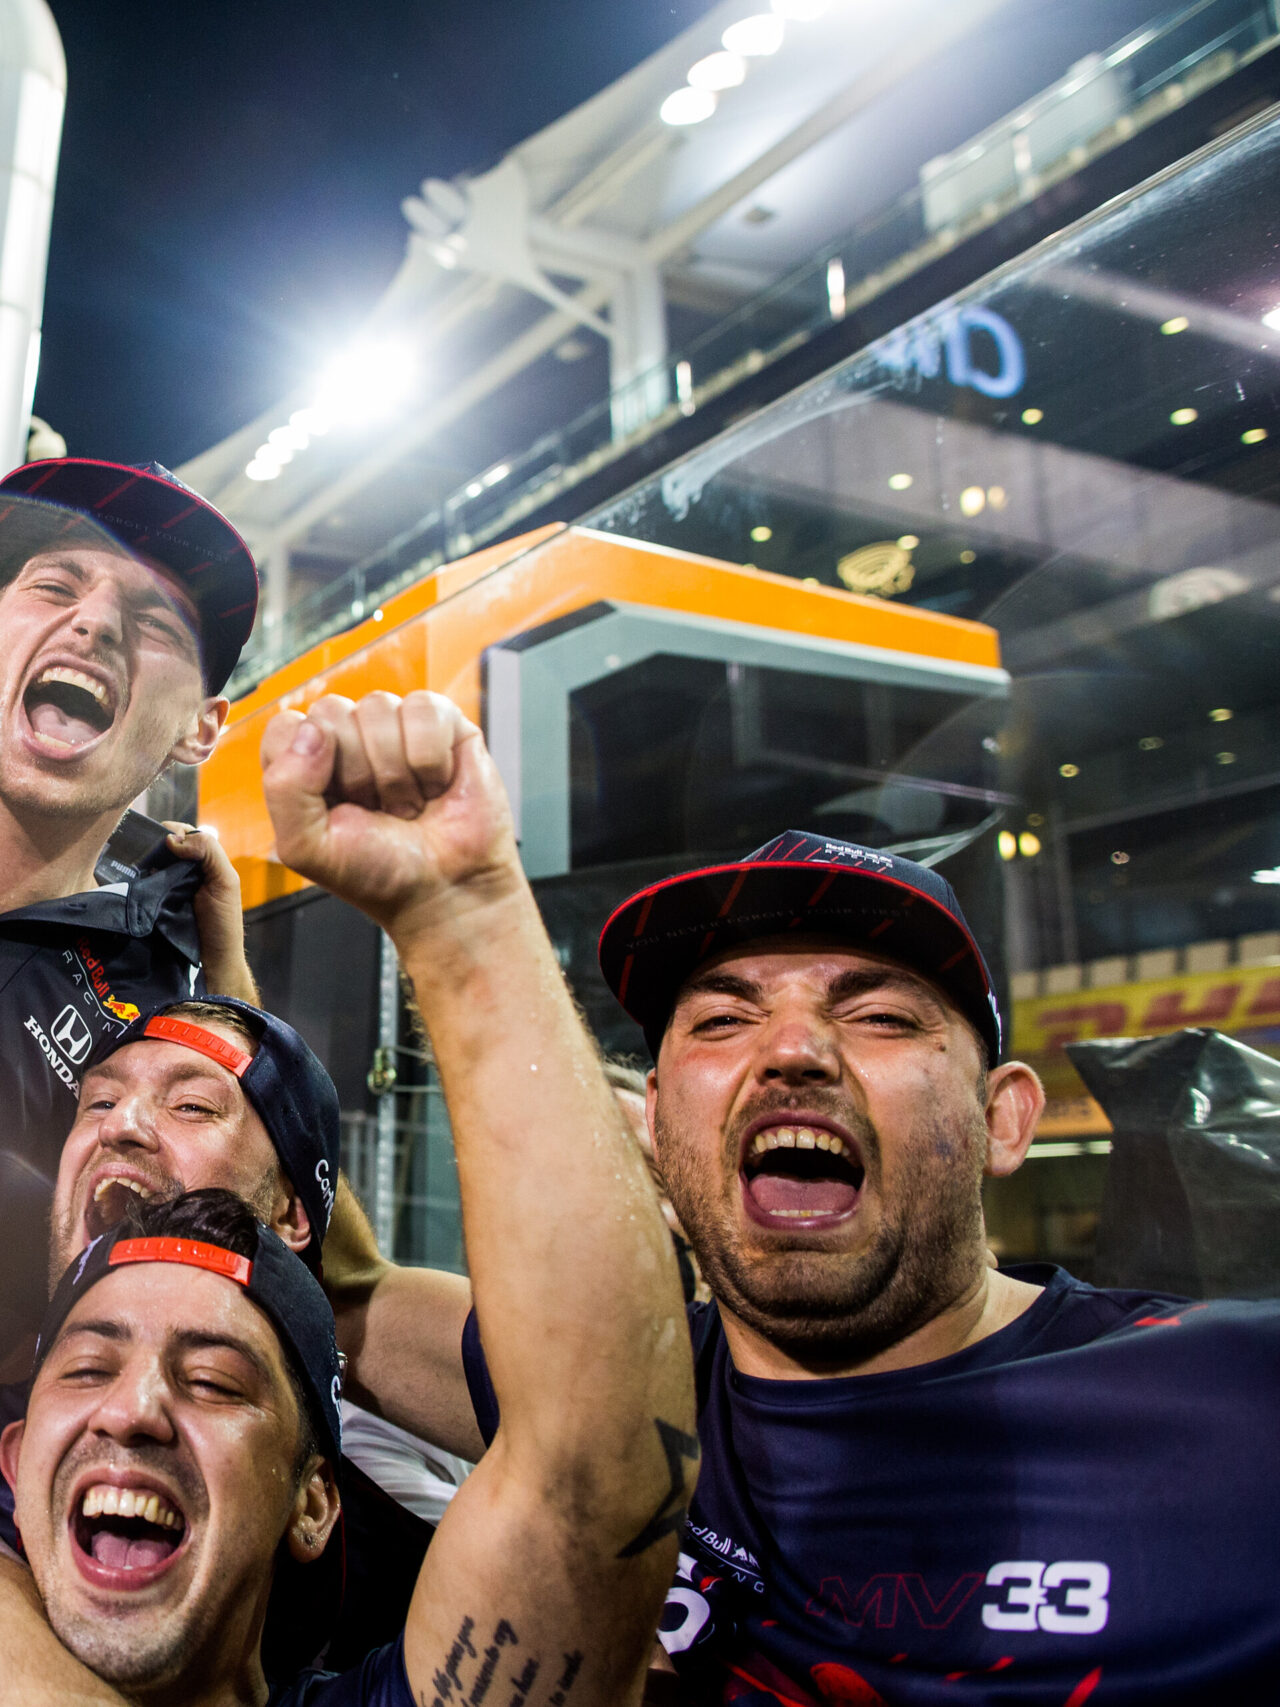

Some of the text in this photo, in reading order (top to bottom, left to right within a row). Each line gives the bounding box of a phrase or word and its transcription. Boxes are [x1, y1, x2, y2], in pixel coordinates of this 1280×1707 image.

[97, 512, 150, 532] FORGET
[156, 529, 191, 548] YOUR
[195, 545, 230, 563] FIRST
[825, 842, 863, 857] Red Bull
[110, 859, 137, 879] PUMA
[665, 918, 720, 938] NEVER
[76, 935, 111, 998] Red Bull
[23, 1014, 81, 1101] HONDA
[701, 1531, 733, 1556] Bull
